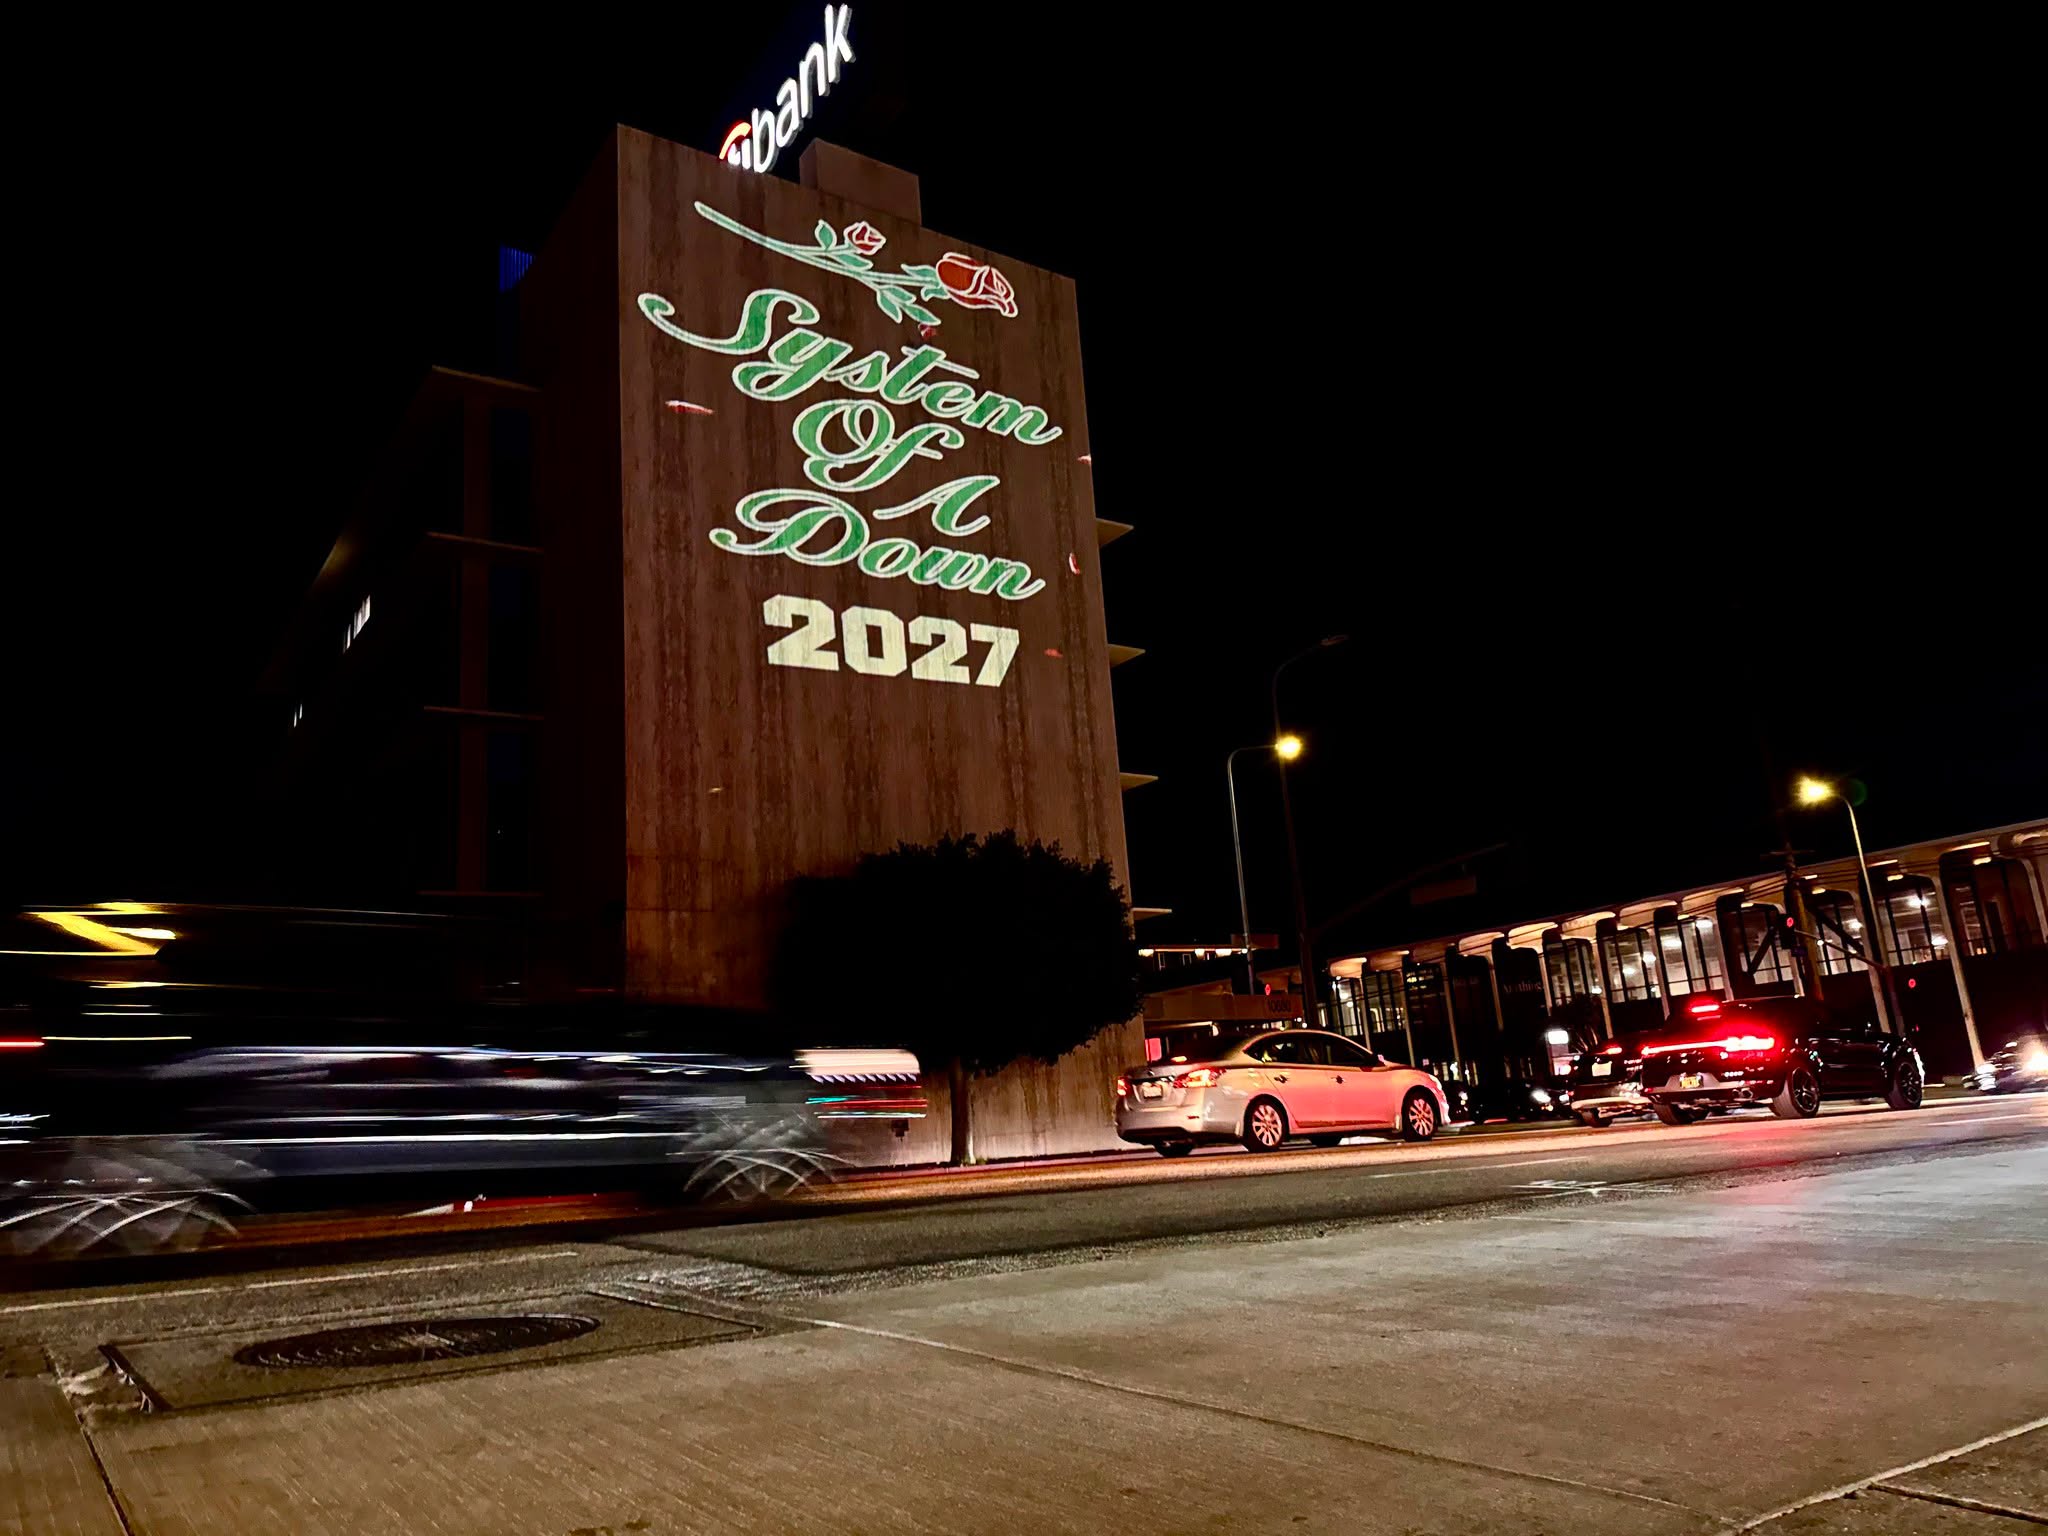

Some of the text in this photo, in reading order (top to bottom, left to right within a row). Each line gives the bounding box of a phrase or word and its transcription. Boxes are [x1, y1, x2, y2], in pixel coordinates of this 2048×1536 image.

[637, 288, 1063, 445] System
[792, 399, 1001, 538] Of A
[708, 488, 1046, 600] Down
[762, 594, 1021, 688] 2027
